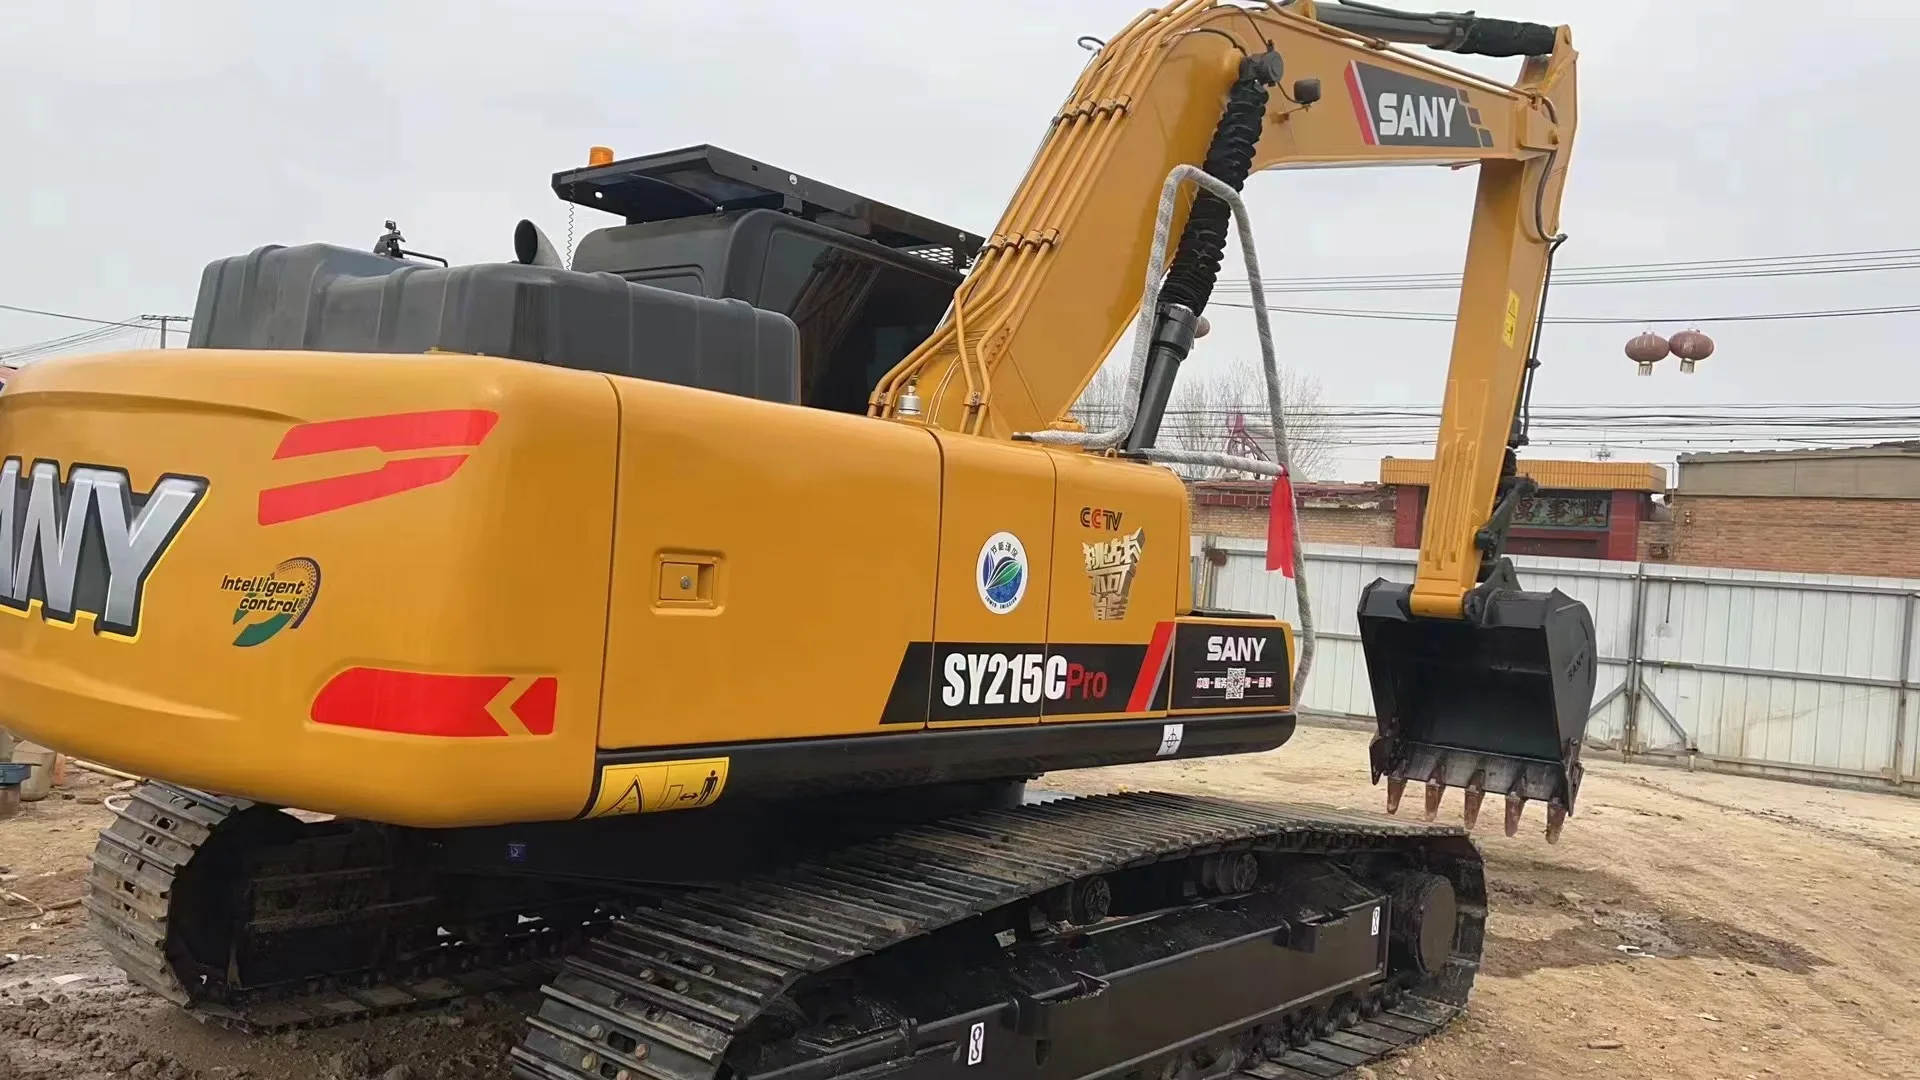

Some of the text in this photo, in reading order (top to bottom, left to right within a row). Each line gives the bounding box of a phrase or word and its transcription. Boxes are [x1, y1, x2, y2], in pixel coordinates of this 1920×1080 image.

[1378, 92, 1457, 137] SANY
[1080, 507, 1122, 531] CCTV
[221, 575, 305, 597] Intelligent
[240, 597, 299, 613] control
[1206, 636, 1267, 662] SANY
